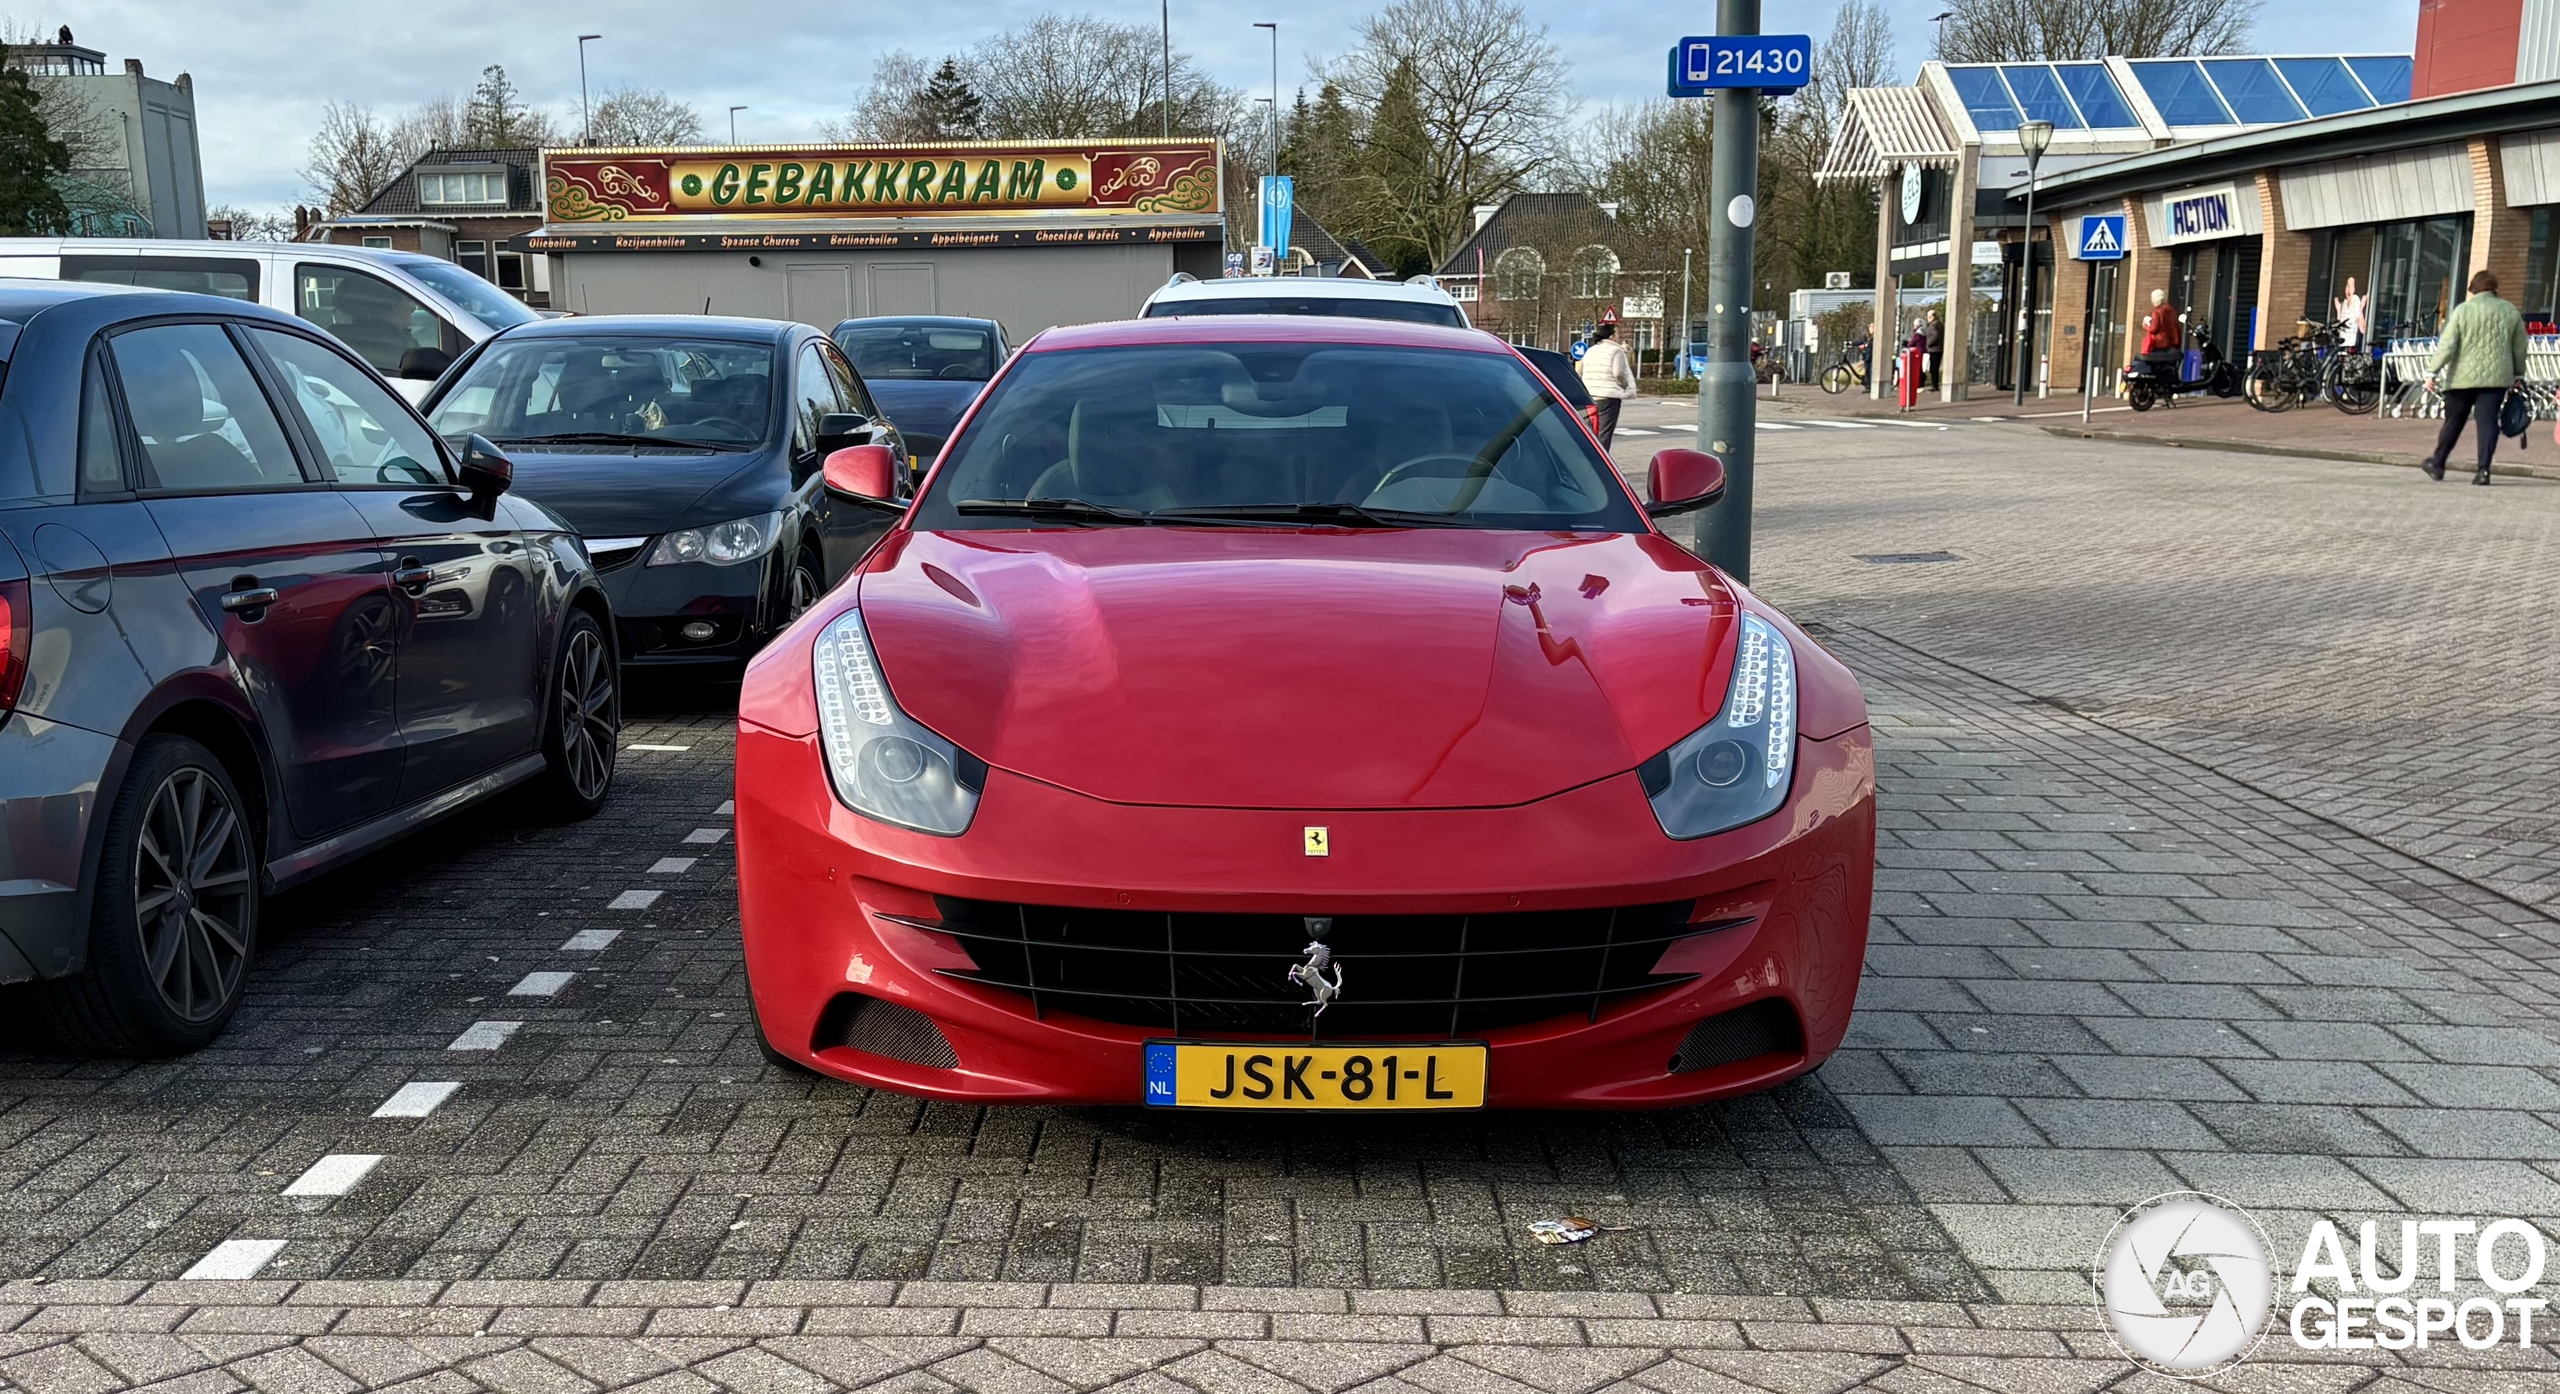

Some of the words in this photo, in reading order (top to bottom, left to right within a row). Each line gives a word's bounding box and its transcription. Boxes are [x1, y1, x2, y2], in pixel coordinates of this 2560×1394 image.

[1716, 49, 1803, 75] 21430
[712, 158, 1046, 206] GEBAKKRAAM
[2173, 192, 2230, 237] ACTION
[528, 238, 577, 249] Oliebollen
[615, 237, 686, 250] Rozijnenbollen
[720, 236, 760, 249] Spaanse
[762, 235, 800, 246] Churros
[830, 234, 899, 246] Berlinerbollen
[931, 233, 1000, 247] Appelbeignets
[1035, 230, 1084, 241] Chocolade
[1087, 229, 1120, 241] Wafels
[1148, 227, 1206, 243] Appelbollen
[1149, 1081, 1172, 1095] NL
[1209, 1054, 1454, 1101] JSK-81-L
